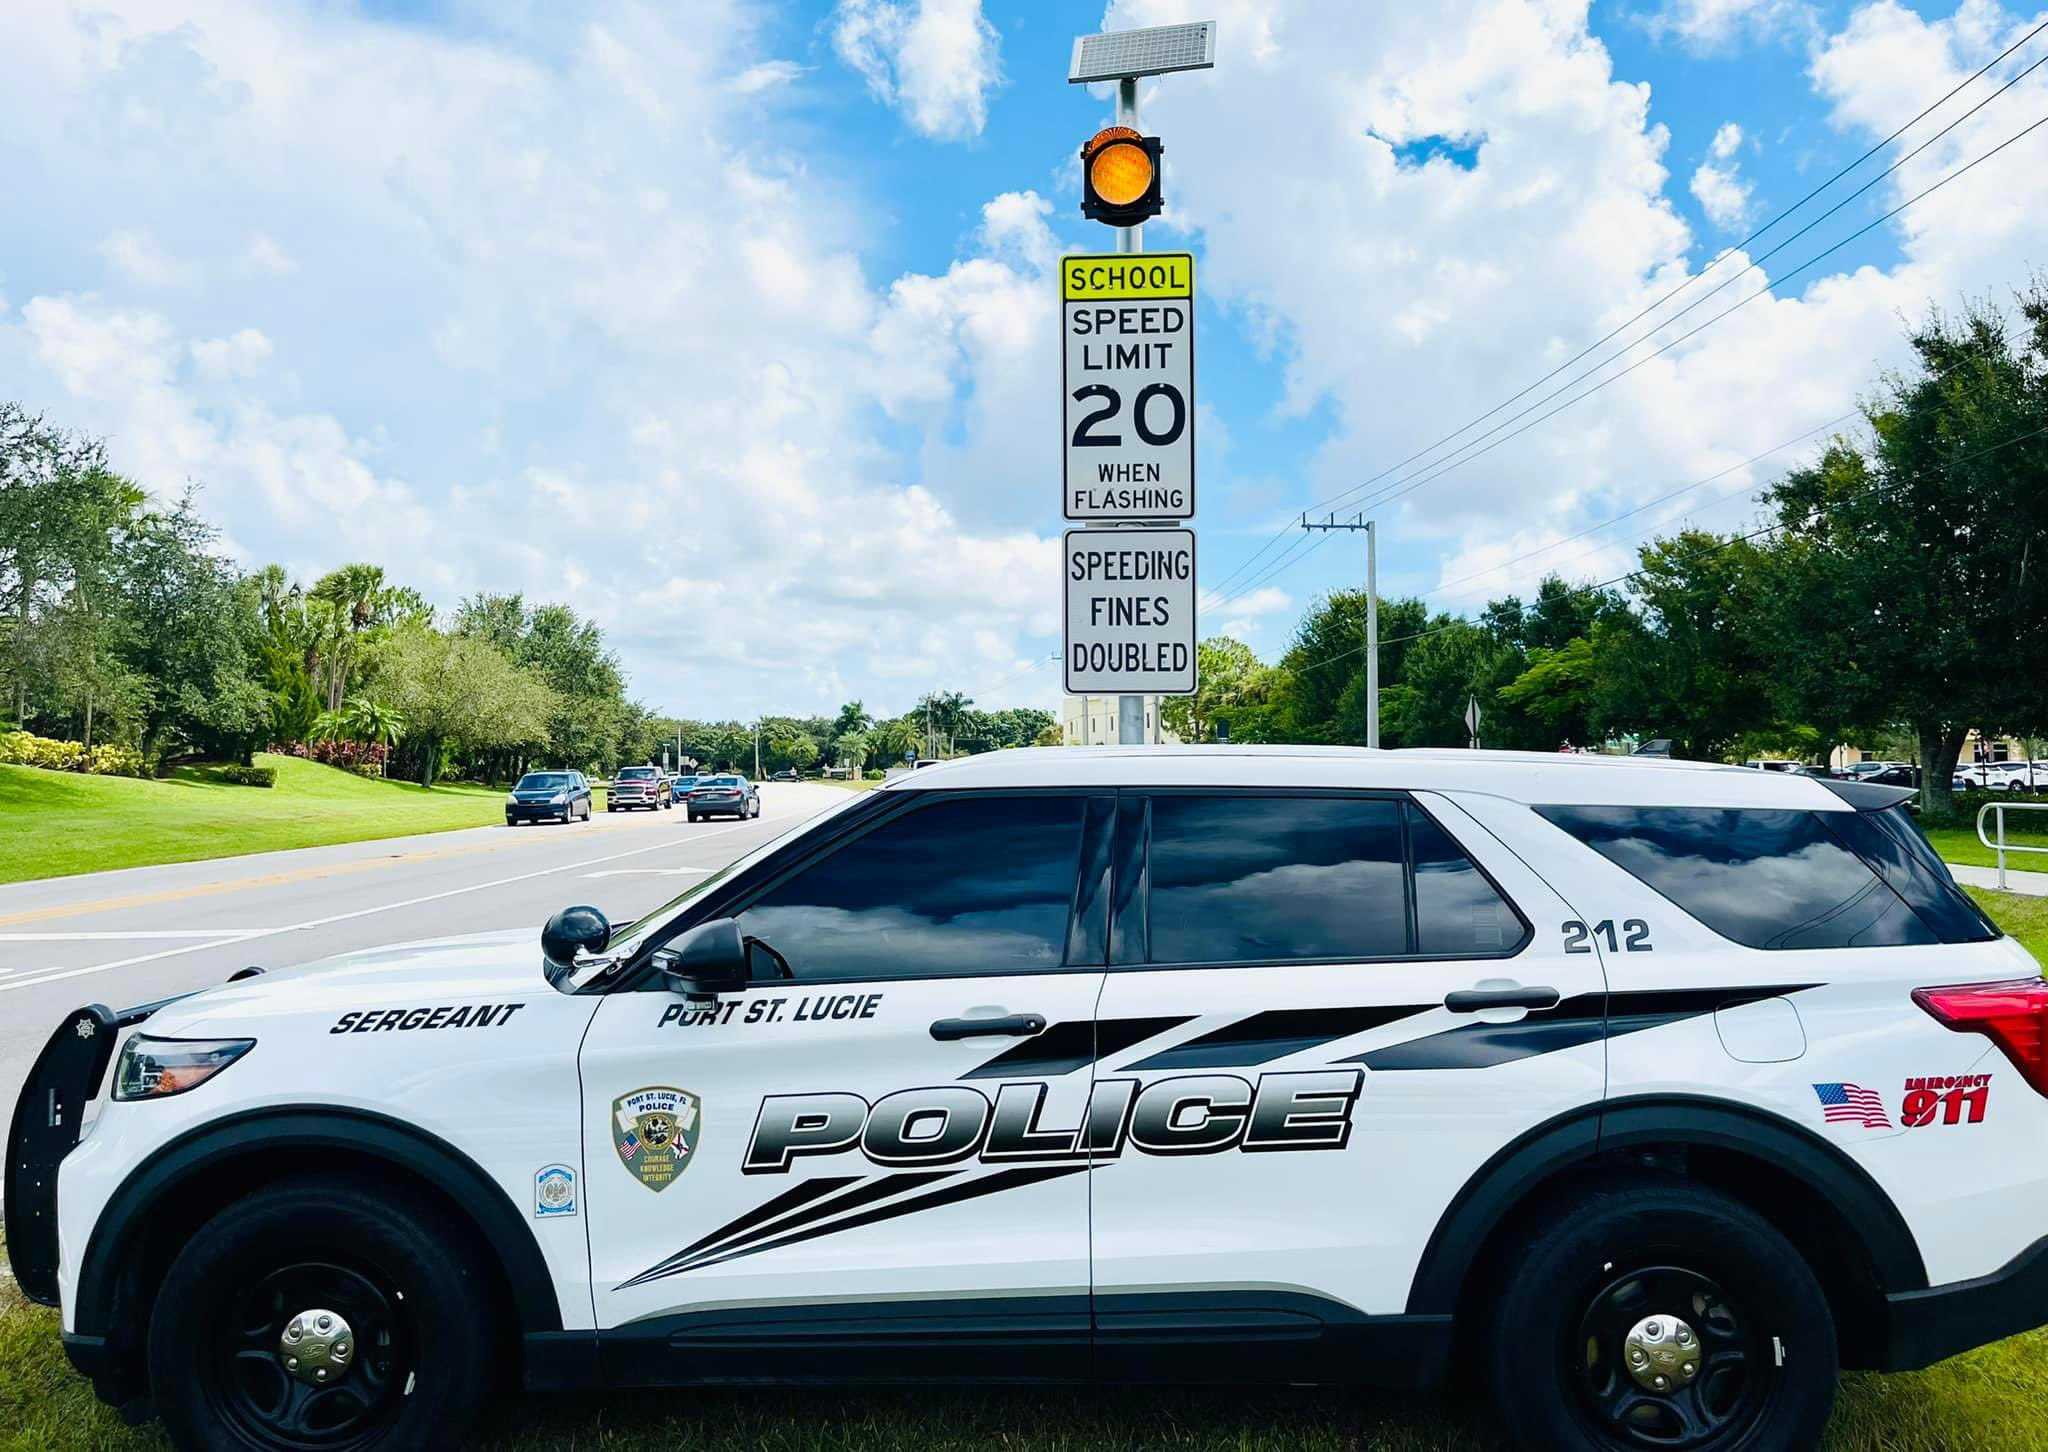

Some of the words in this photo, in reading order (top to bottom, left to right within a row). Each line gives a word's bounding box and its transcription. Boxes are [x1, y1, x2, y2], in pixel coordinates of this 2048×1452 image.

[1071, 265, 1185, 291] SCHOOL
[1072, 307, 1184, 335] SPEED
[1083, 343, 1172, 370] LIMIT
[1072, 383, 1186, 447] 20
[1098, 463, 1160, 482] WHEN
[1075, 490, 1183, 509] FLASHING
[1071, 550, 1189, 581] SPEEDING
[1091, 597, 1169, 626] FINES
[1073, 643, 1188, 672] DOUBLED
[1561, 918, 1653, 953] 212
[329, 1003, 526, 1034] SERGEANT
[657, 1000, 743, 1028] PORT
[743, 998, 788, 1024] ST.
[792, 993, 883, 1022] LUCIE
[627, 1095, 645, 1107] PORT
[639, 1103, 675, 1113] POLICE
[1901, 1087, 1985, 1126] 911
[741, 1069, 1364, 1175] POLICE
